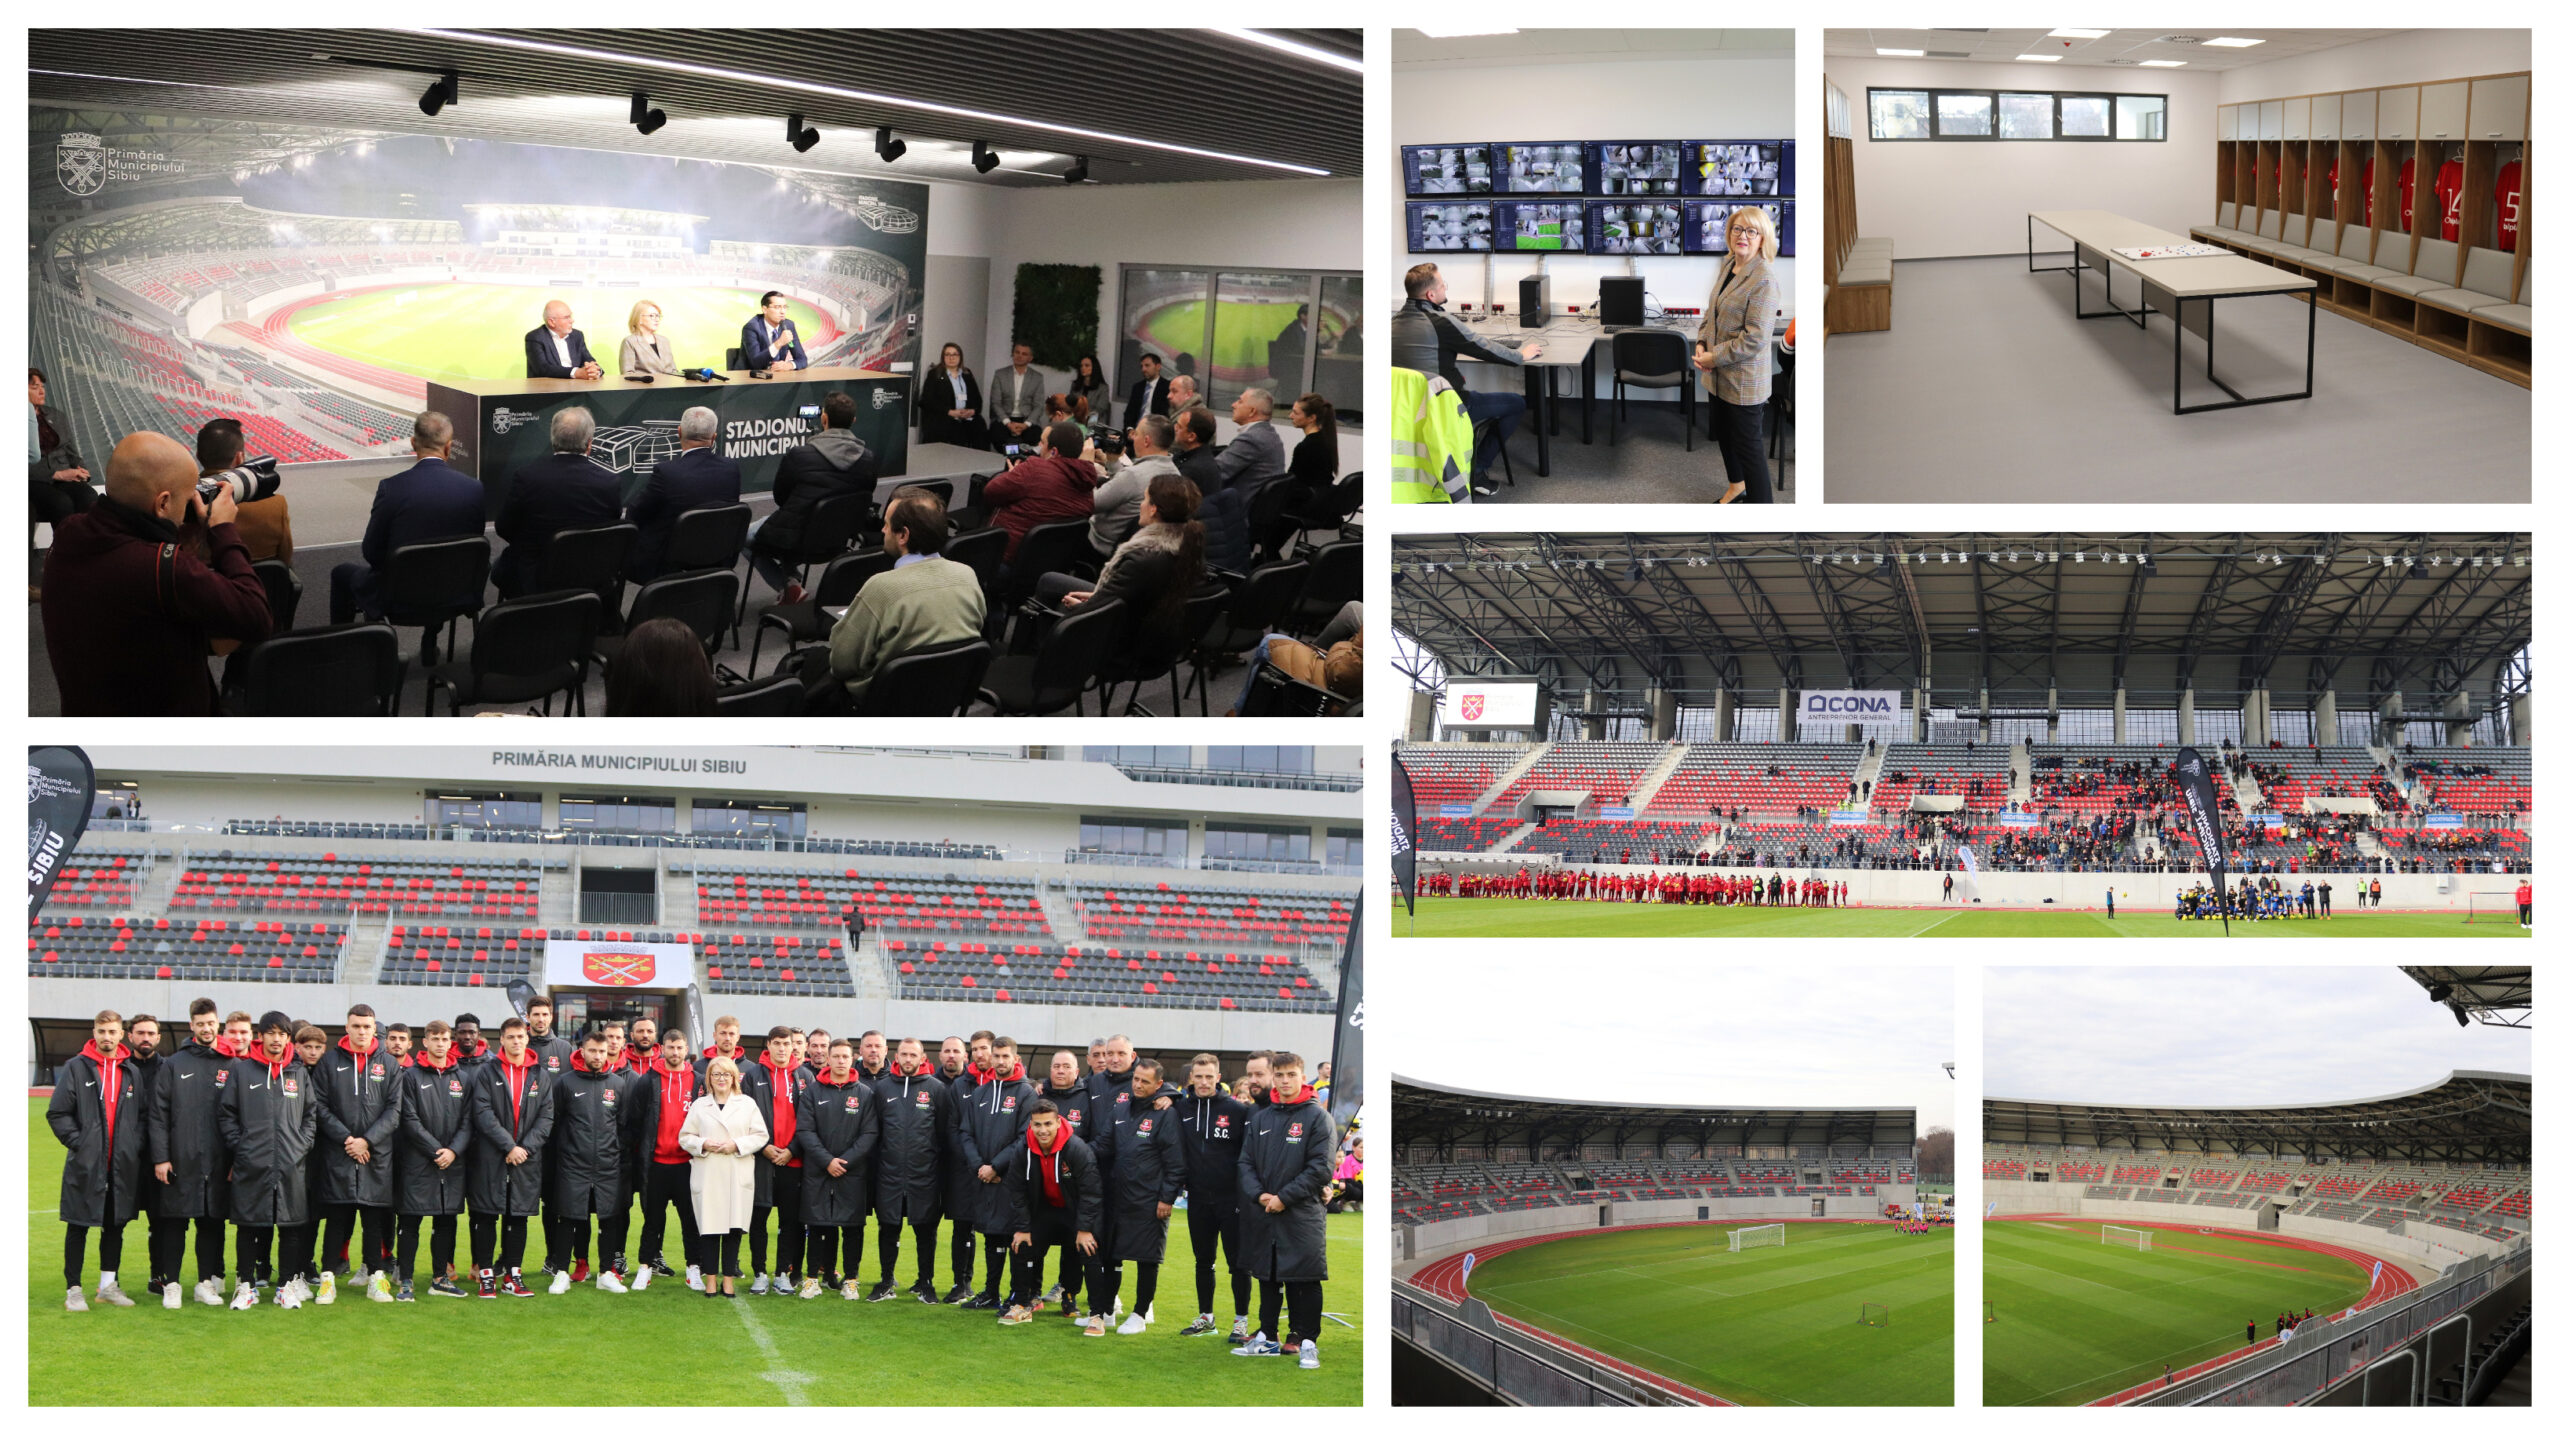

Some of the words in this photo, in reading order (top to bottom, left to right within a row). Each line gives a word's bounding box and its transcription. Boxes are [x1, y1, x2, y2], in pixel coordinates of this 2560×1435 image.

[108, 148, 164, 160] Primăria
[108, 159, 185, 173] Municipiului
[108, 170, 140, 181] Sibiu
[2504, 191, 2520, 222] 5
[1828, 696, 1891, 712] CONA
[492, 750, 577, 768] PRIMĂRIA
[581, 755, 698, 772] MUNICIPIULUI
[702, 759, 747, 774] SIBIU
[28, 830, 64, 885] SIBIU
[1213, 1127, 1230, 1139] S.C.
